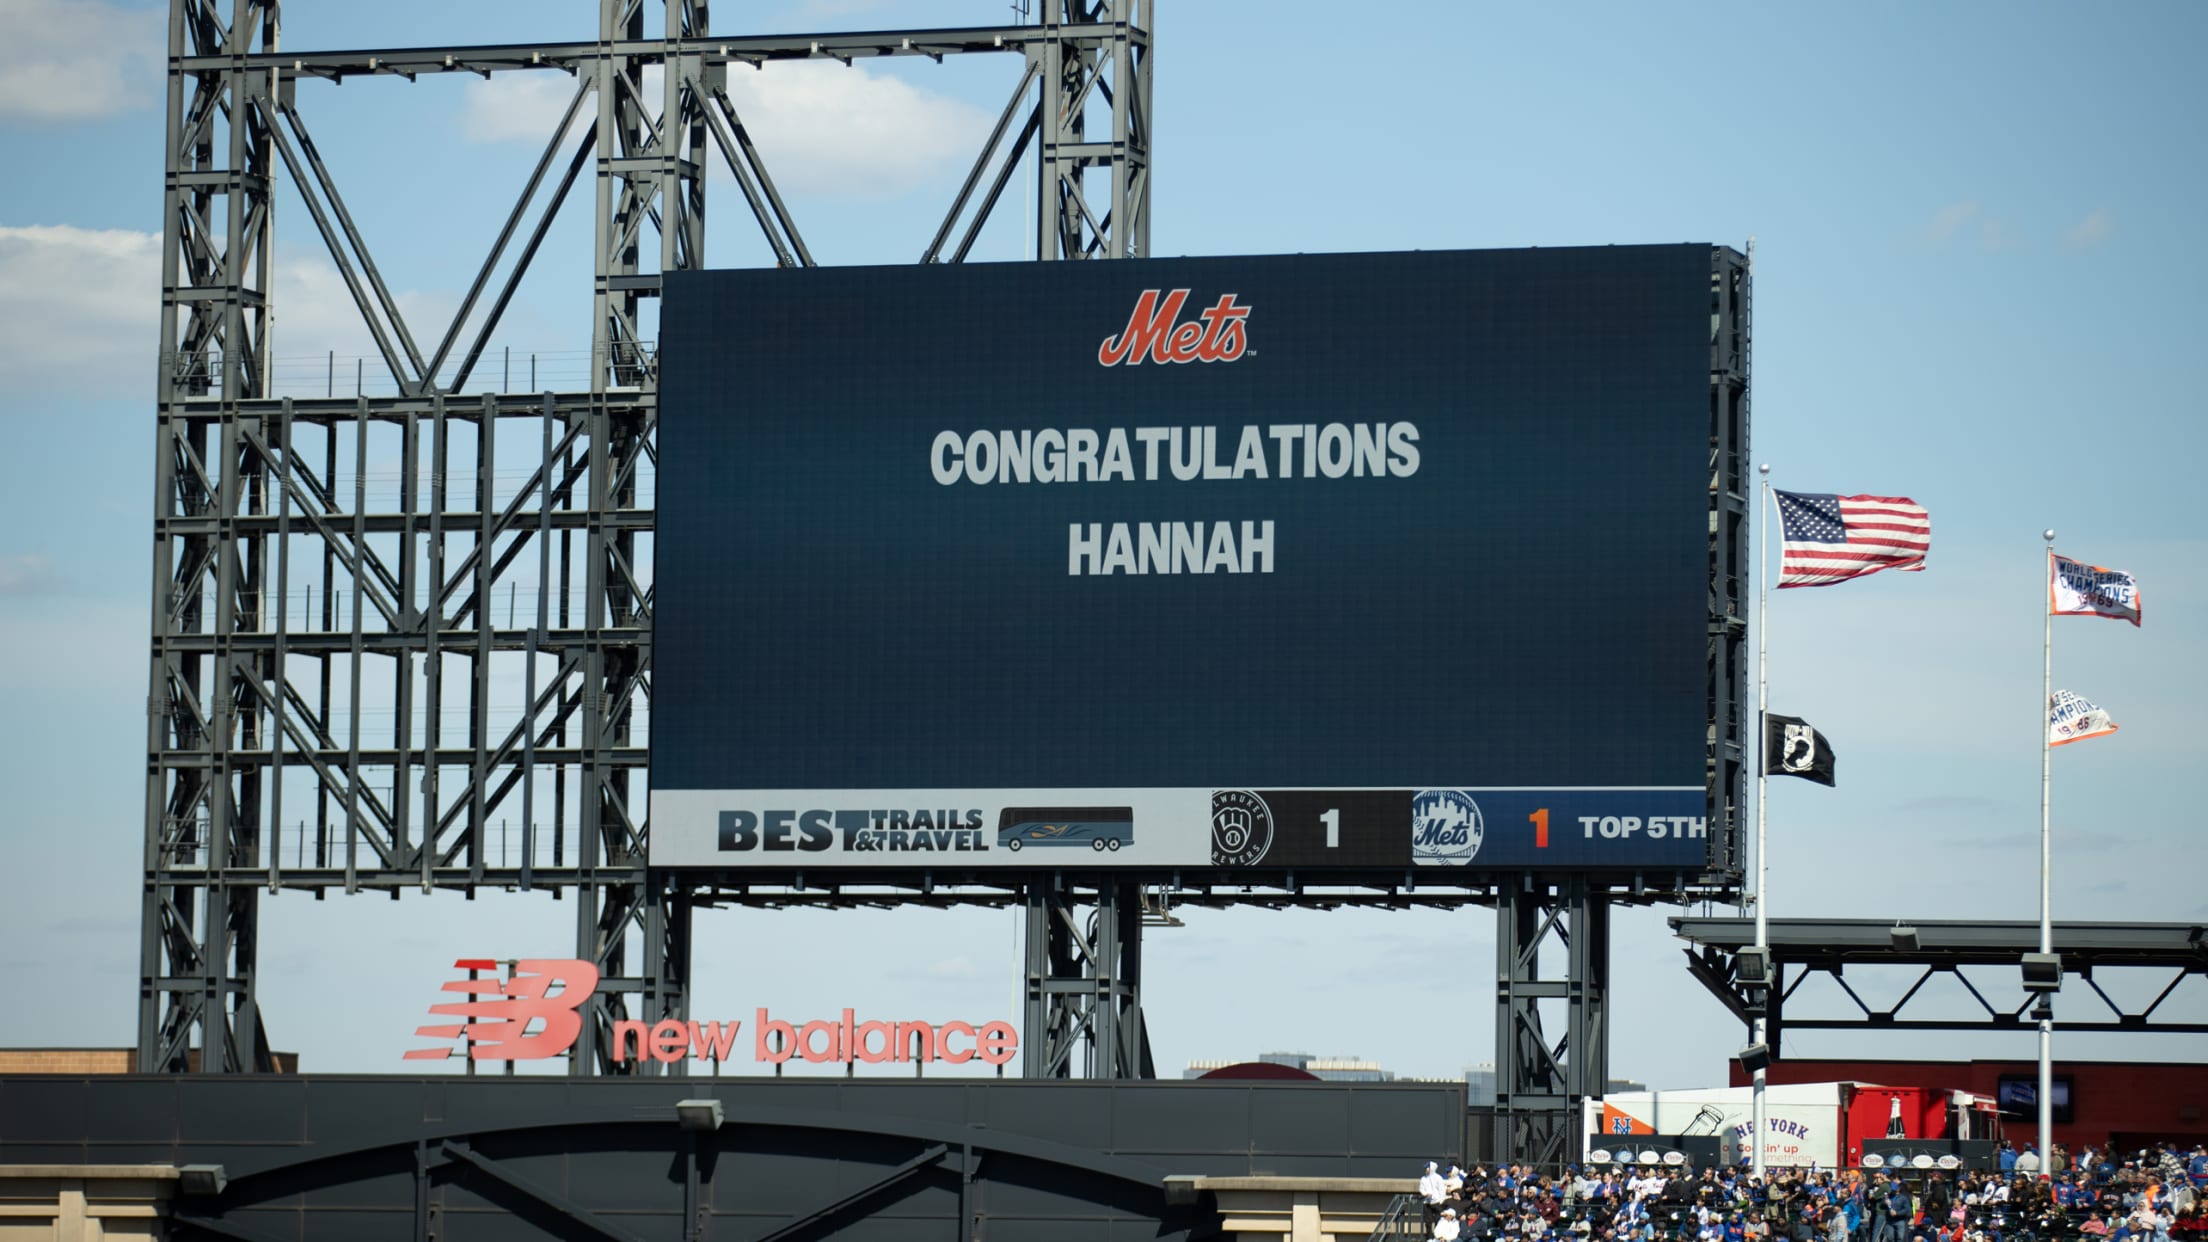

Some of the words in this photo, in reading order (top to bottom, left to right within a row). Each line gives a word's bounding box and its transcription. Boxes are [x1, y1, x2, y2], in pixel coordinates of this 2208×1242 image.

[1098, 288, 1252, 367] Mets
[930, 421, 1421, 485] CONGRATULATIONS
[1068, 520, 1275, 575] HANNAH
[2059, 561, 2093, 578] WORLD
[2093, 572, 2131, 586] SERIES
[2050, 699, 2100, 725] AMPION
[871, 809, 984, 830] TRAILS
[1212, 793, 1265, 820] LWAUKEE
[717, 809, 871, 852] BEST
[1319, 808, 1340, 848] 1
[1414, 818, 1470, 846] Mets
[1528, 808, 1550, 848] 1
[1577, 816, 1642, 839] TOP
[1646, 816, 1707, 839] 5TH
[1212, 844, 1261, 865] REWERS
[613, 1018, 741, 1063] new
[755, 1007, 1019, 1065] balance
[1734, 1119, 1766, 1139] NE
[1770, 1118, 1809, 1140] YORK
[1736, 1143, 1780, 1153] Coin'
[1783, 1145, 1799, 1155] up
